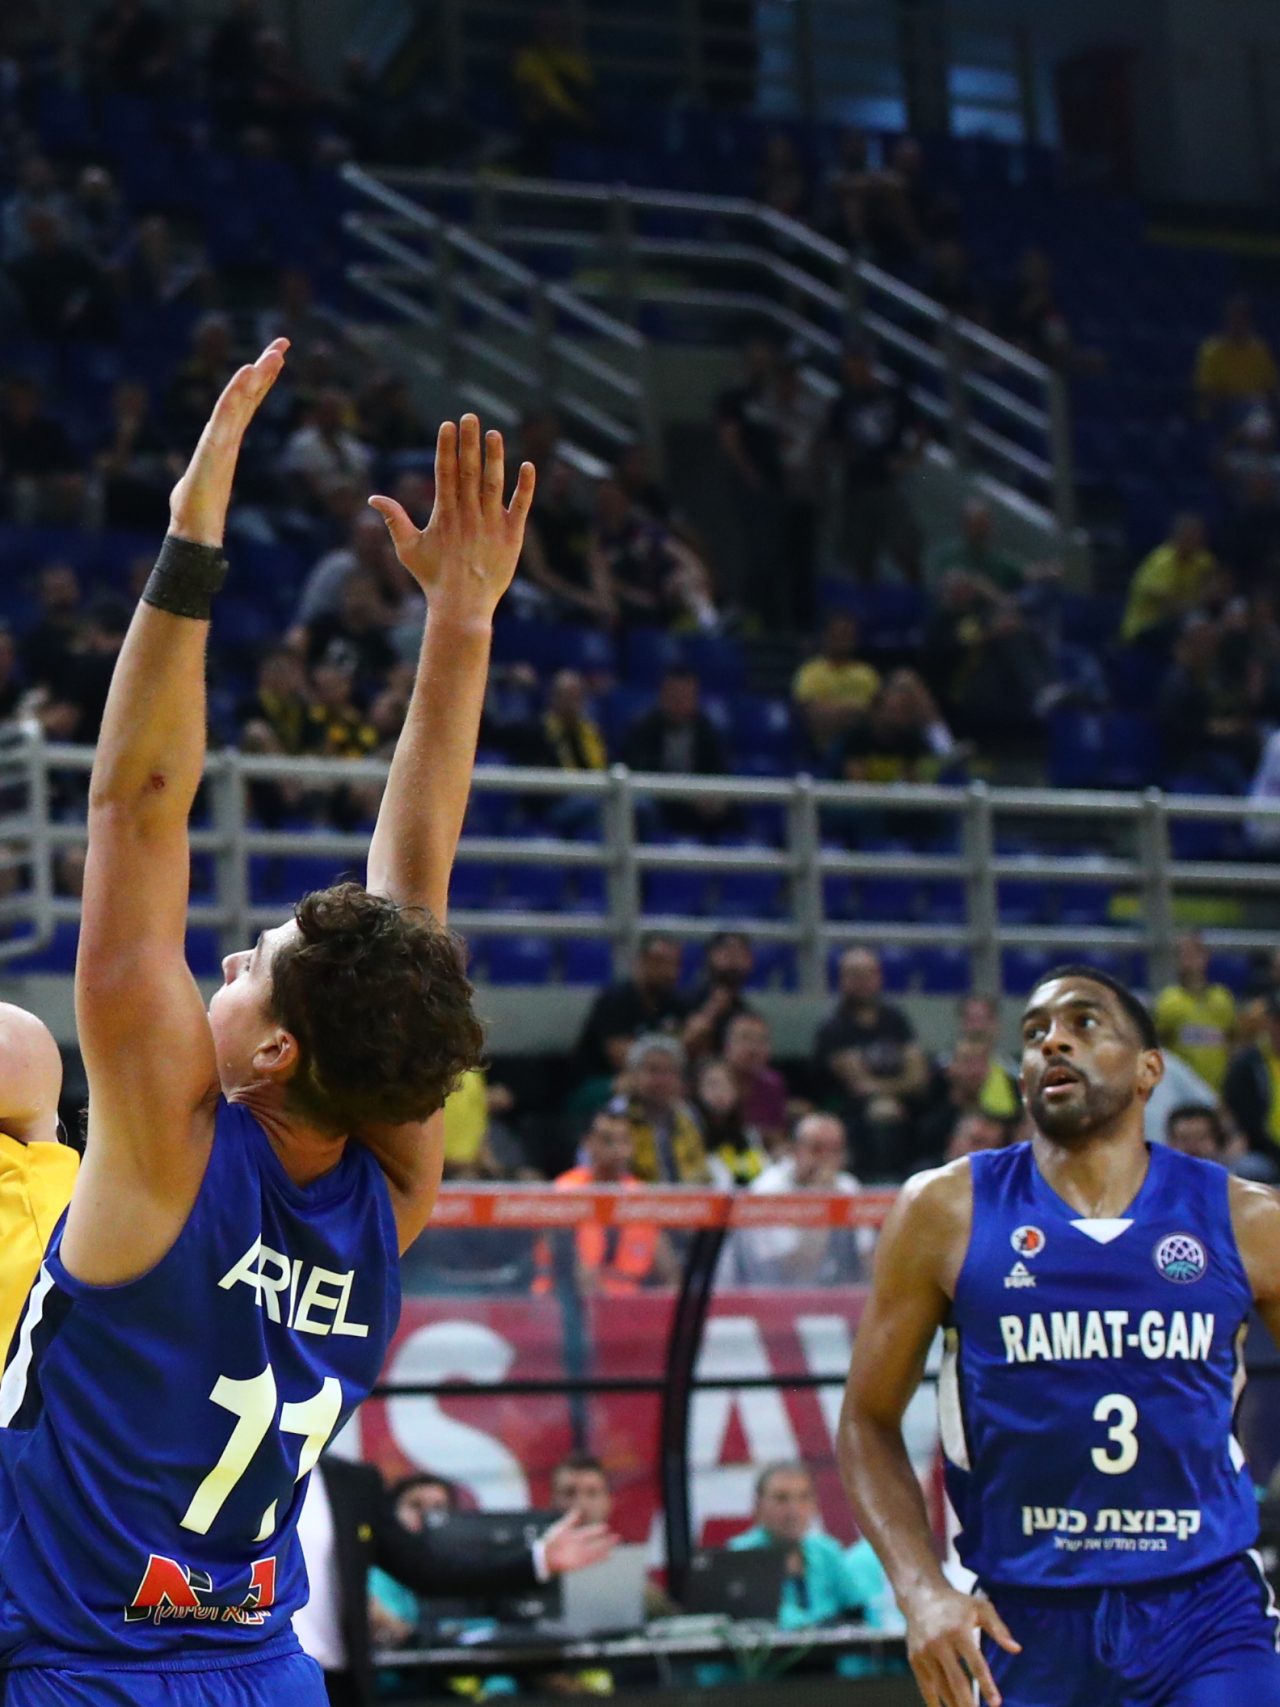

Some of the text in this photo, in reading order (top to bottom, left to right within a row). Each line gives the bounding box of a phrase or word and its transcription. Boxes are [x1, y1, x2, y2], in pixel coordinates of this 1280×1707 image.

[218, 1233, 369, 1338] ARIEL
[999, 1310, 1215, 1363] RAMAT-GAN
[1091, 1394, 1139, 1475] 3
[1022, 1506, 1201, 1541] קבוצת כנען
